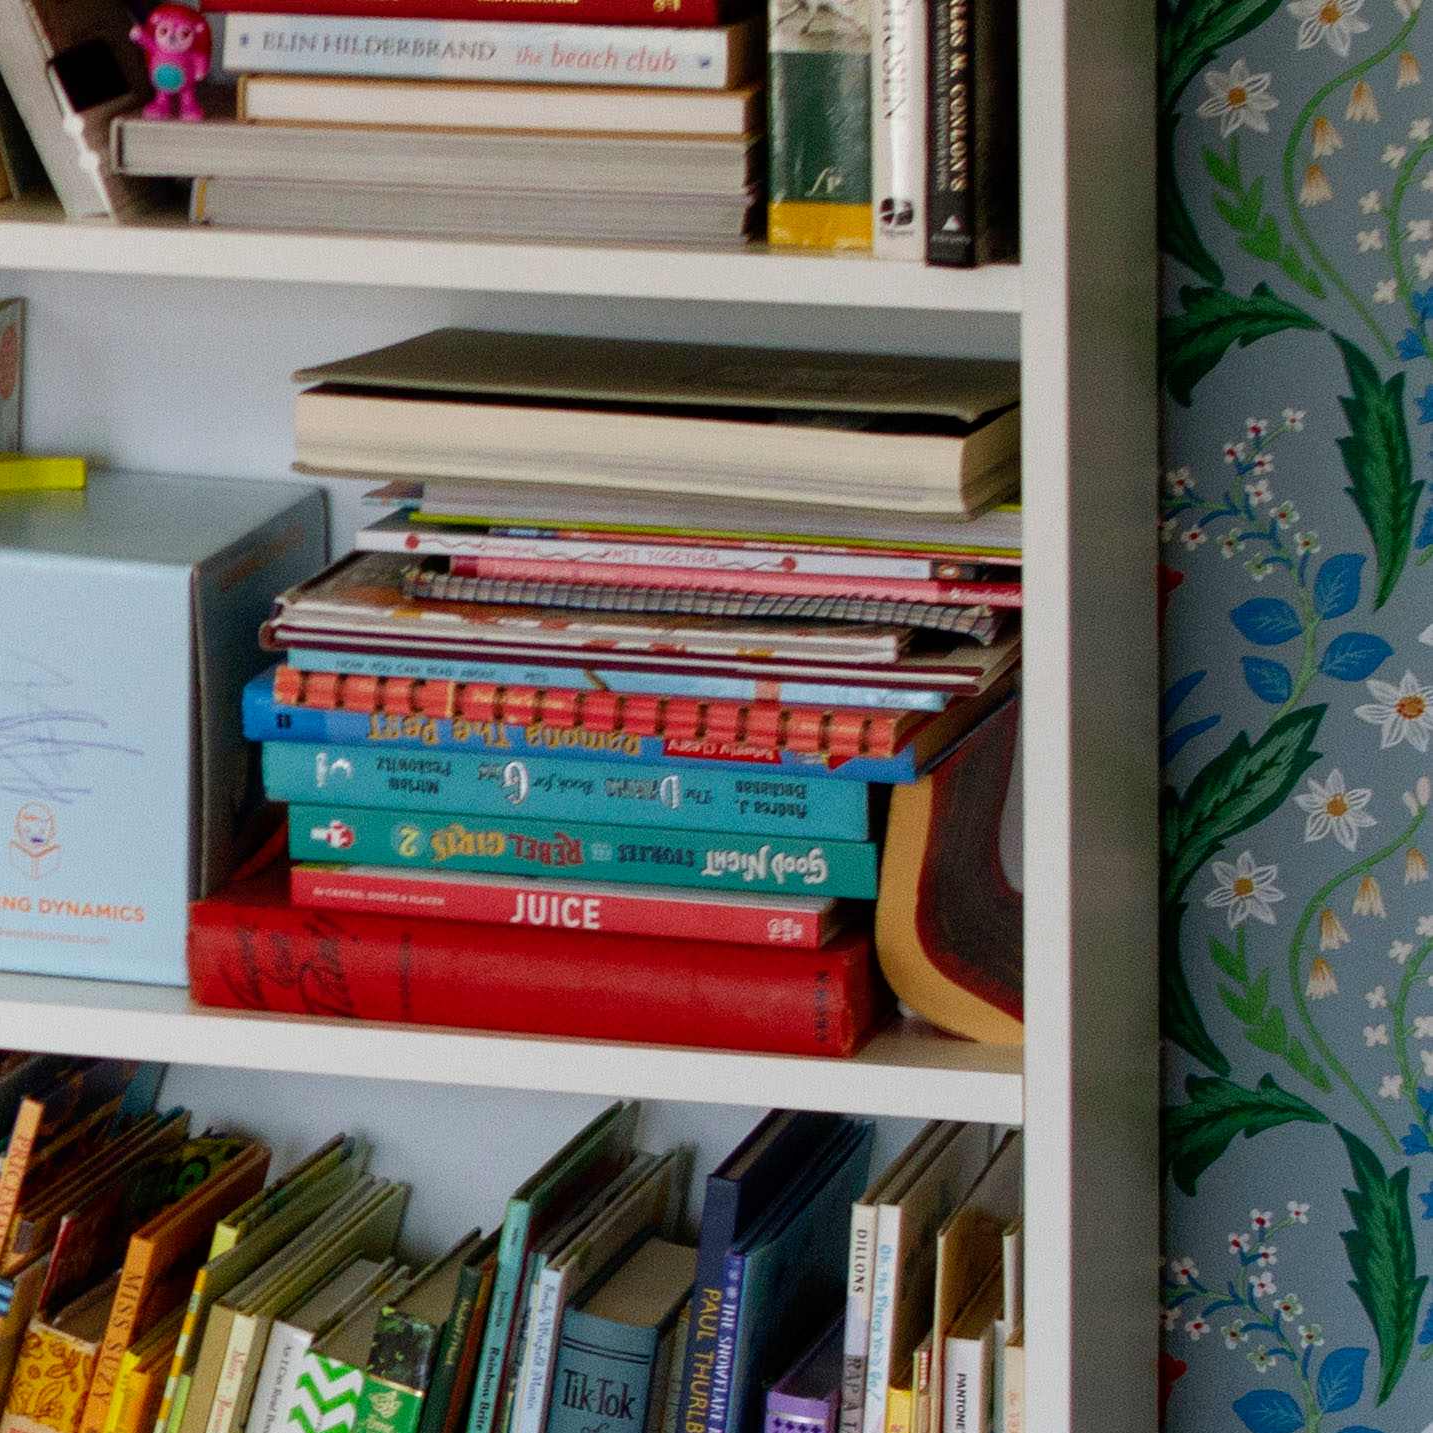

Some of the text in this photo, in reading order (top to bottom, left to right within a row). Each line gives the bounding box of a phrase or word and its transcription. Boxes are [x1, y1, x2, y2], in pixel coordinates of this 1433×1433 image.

[516, 40, 677, 74] the beach club
[375, 757, 451, 779] Peskowitz
[388, 777, 439, 795] Miriam
[736, 780, 807, 800] Buchanan
[398, 823, 583, 867] REBEL GIRLS 2
[38, 897, 145, 923] DYNAMICS
[509, 893, 601, 929] JUICE
[852, 1228, 867, 1293] DILLONS
[696, 1287, 721, 1341] PAUL
[719, 1303, 736, 1332] THE
[91, 1273, 144, 1400] MISS SUZY
[707, 1335, 735, 1423] SNOWFLAKE
[843, 1357, 865, 1393] RAP
[843, 1401, 860, 1412] A
